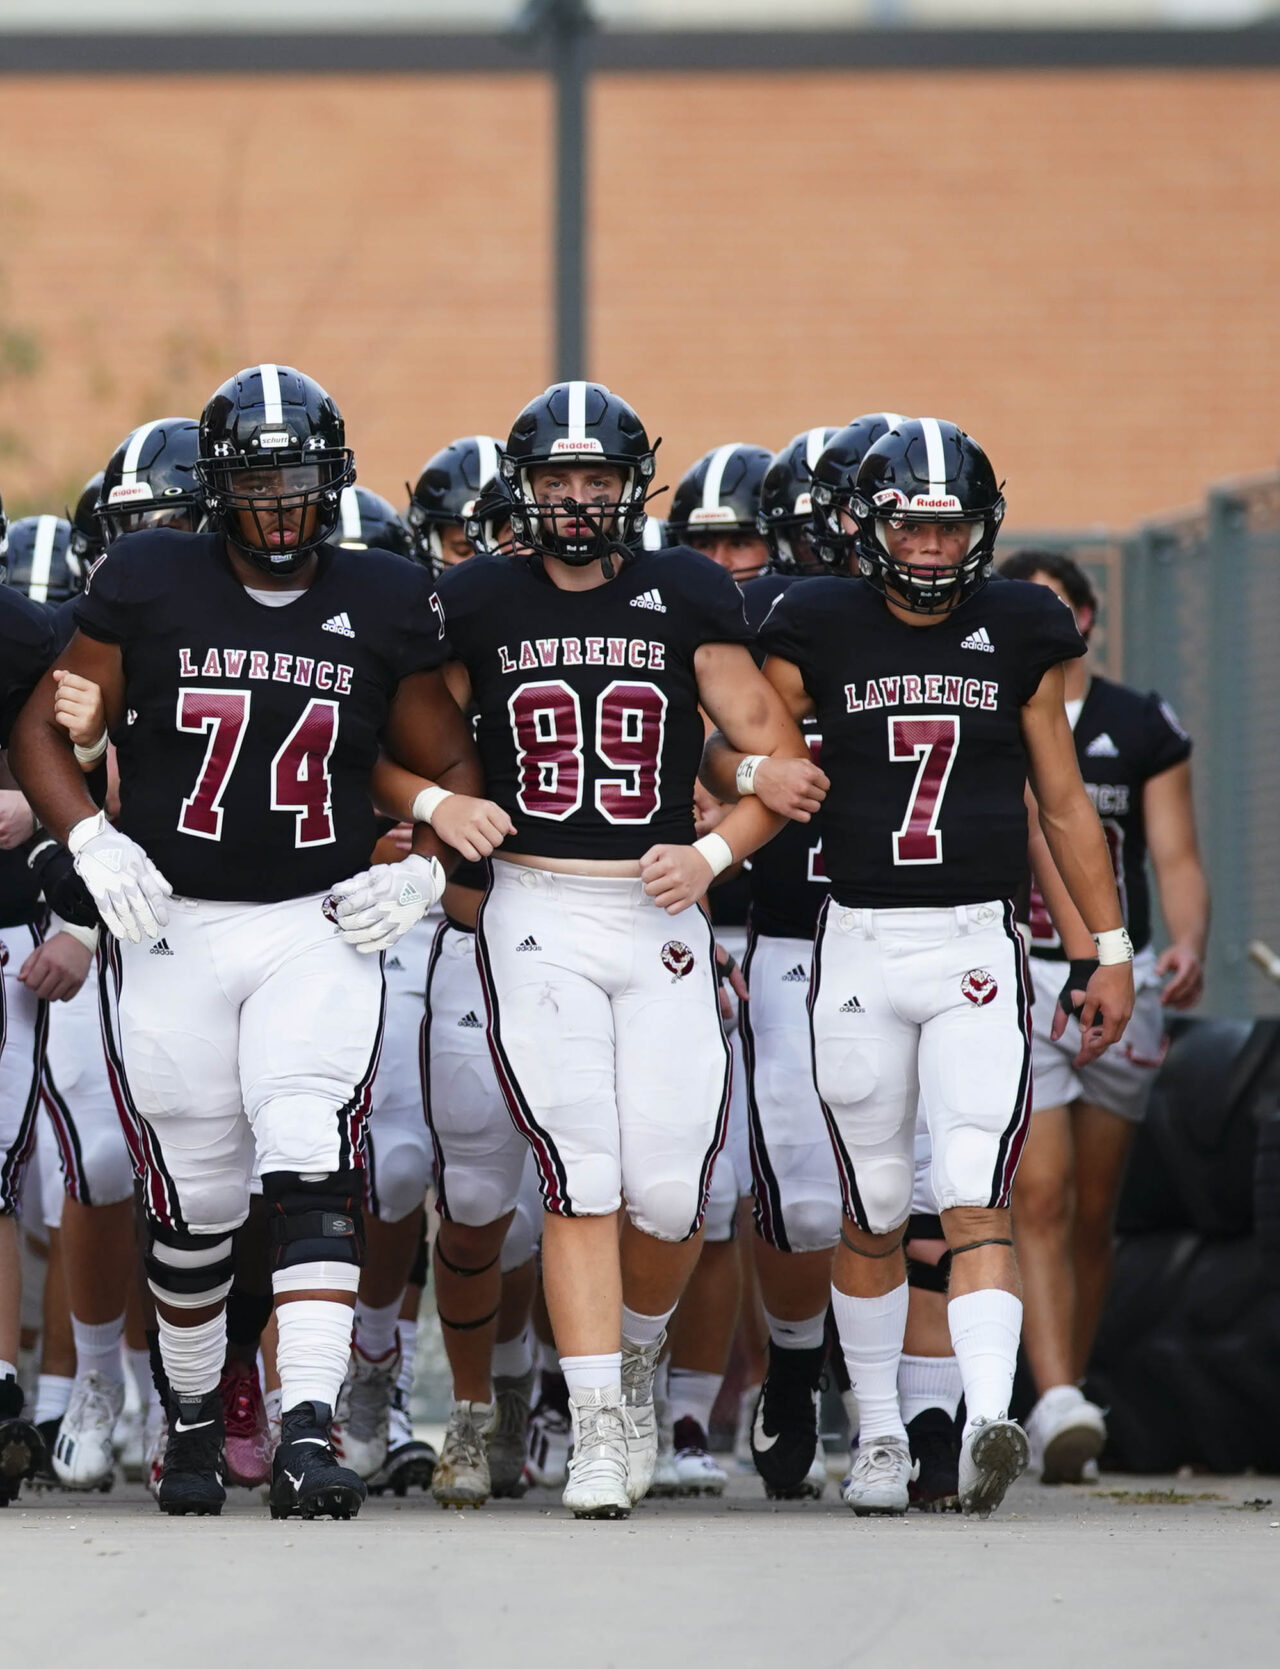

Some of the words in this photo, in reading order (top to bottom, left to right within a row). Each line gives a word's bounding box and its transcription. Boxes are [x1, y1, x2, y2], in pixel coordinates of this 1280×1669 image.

[557, 442, 597, 450] Riddell
[916, 498, 956, 508] Riddell
[629, 599, 667, 613] adidas
[321, 622, 355, 639] adidas
[496, 636, 666, 675] LAWRENCE
[960, 641, 995, 653] adidas
[178, 647, 355, 696] LAWRENCE
[843, 674, 999, 714] LAWRENCE
[506, 679, 670, 826] 89
[176, 687, 341, 850] 74
[887, 715, 961, 866] 7
[150, 948, 175, 956] adidas
